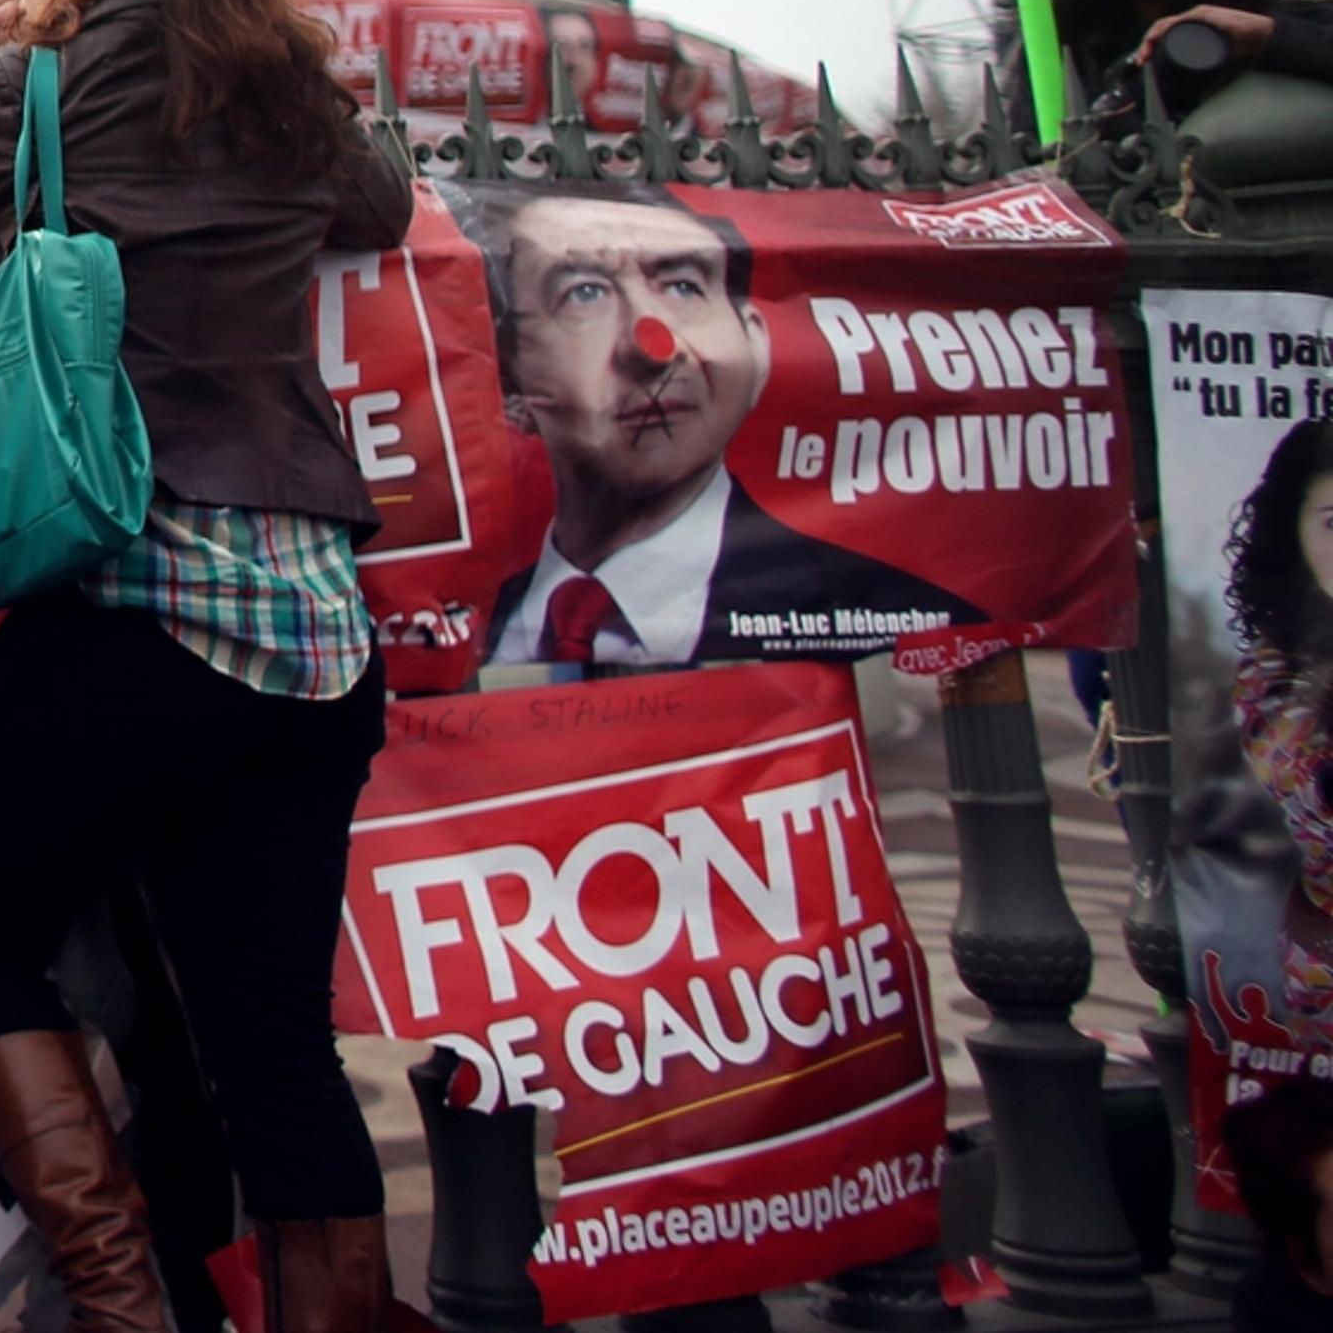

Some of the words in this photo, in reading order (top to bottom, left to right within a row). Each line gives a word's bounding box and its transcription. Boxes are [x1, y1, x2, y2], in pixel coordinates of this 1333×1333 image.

[809, 296, 1109, 395] Prenez
[1169, 321, 1255, 365] Mon
[1256, 375, 1292, 419] la
[777, 425, 826, 480] le
[830, 397, 1115, 505] pouvoir
[730, 610, 831, 637] Jean-Luc
[372, 768, 857, 1021] FRONT
[564, 922, 903, 1097] GAUCHE
[1229, 1039, 1307, 1075] Pour
